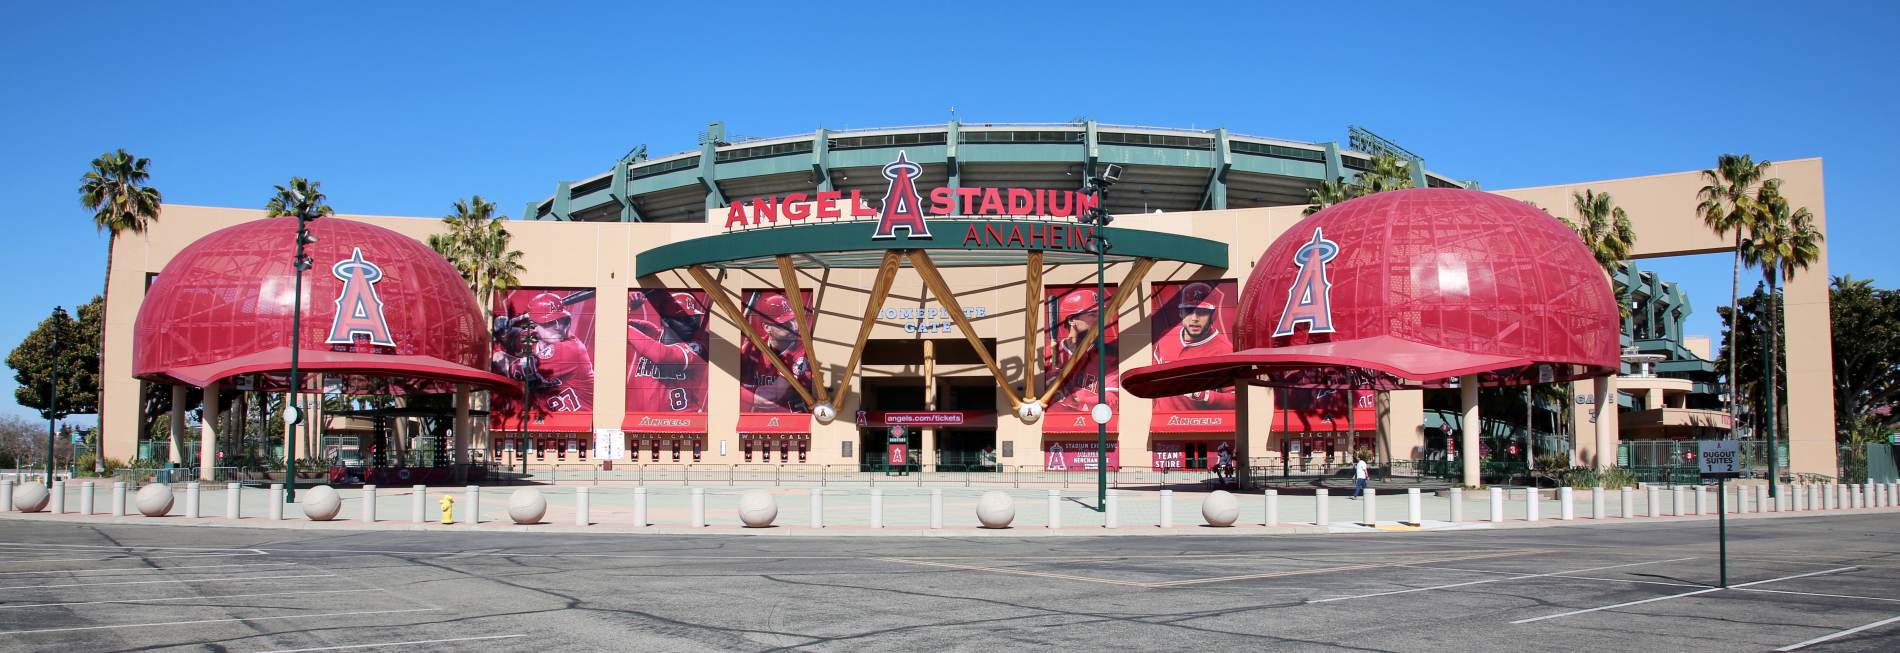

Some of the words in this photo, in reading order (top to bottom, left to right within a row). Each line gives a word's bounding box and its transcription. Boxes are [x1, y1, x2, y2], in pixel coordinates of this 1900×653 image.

[725, 189, 877, 228] ANGEL
[872, 150, 932, 239] A
[929, 186, 1099, 219] STADIUM
[962, 223, 1095, 249] ANAHEIM
[1272, 227, 1336, 337] A
[325, 247, 397, 347] A
[877, 306, 986, 320] OMEPLTE
[904, 320, 951, 333] GATE
[670, 388, 687, 410] 8
[638, 416, 691, 426] ANGELS
[887, 414, 961, 423] angels.com/tickets
[1167, 415, 1222, 426] ANGELS
[1157, 452, 1178, 460] TEAM
[1155, 460, 1181, 468] STORE
